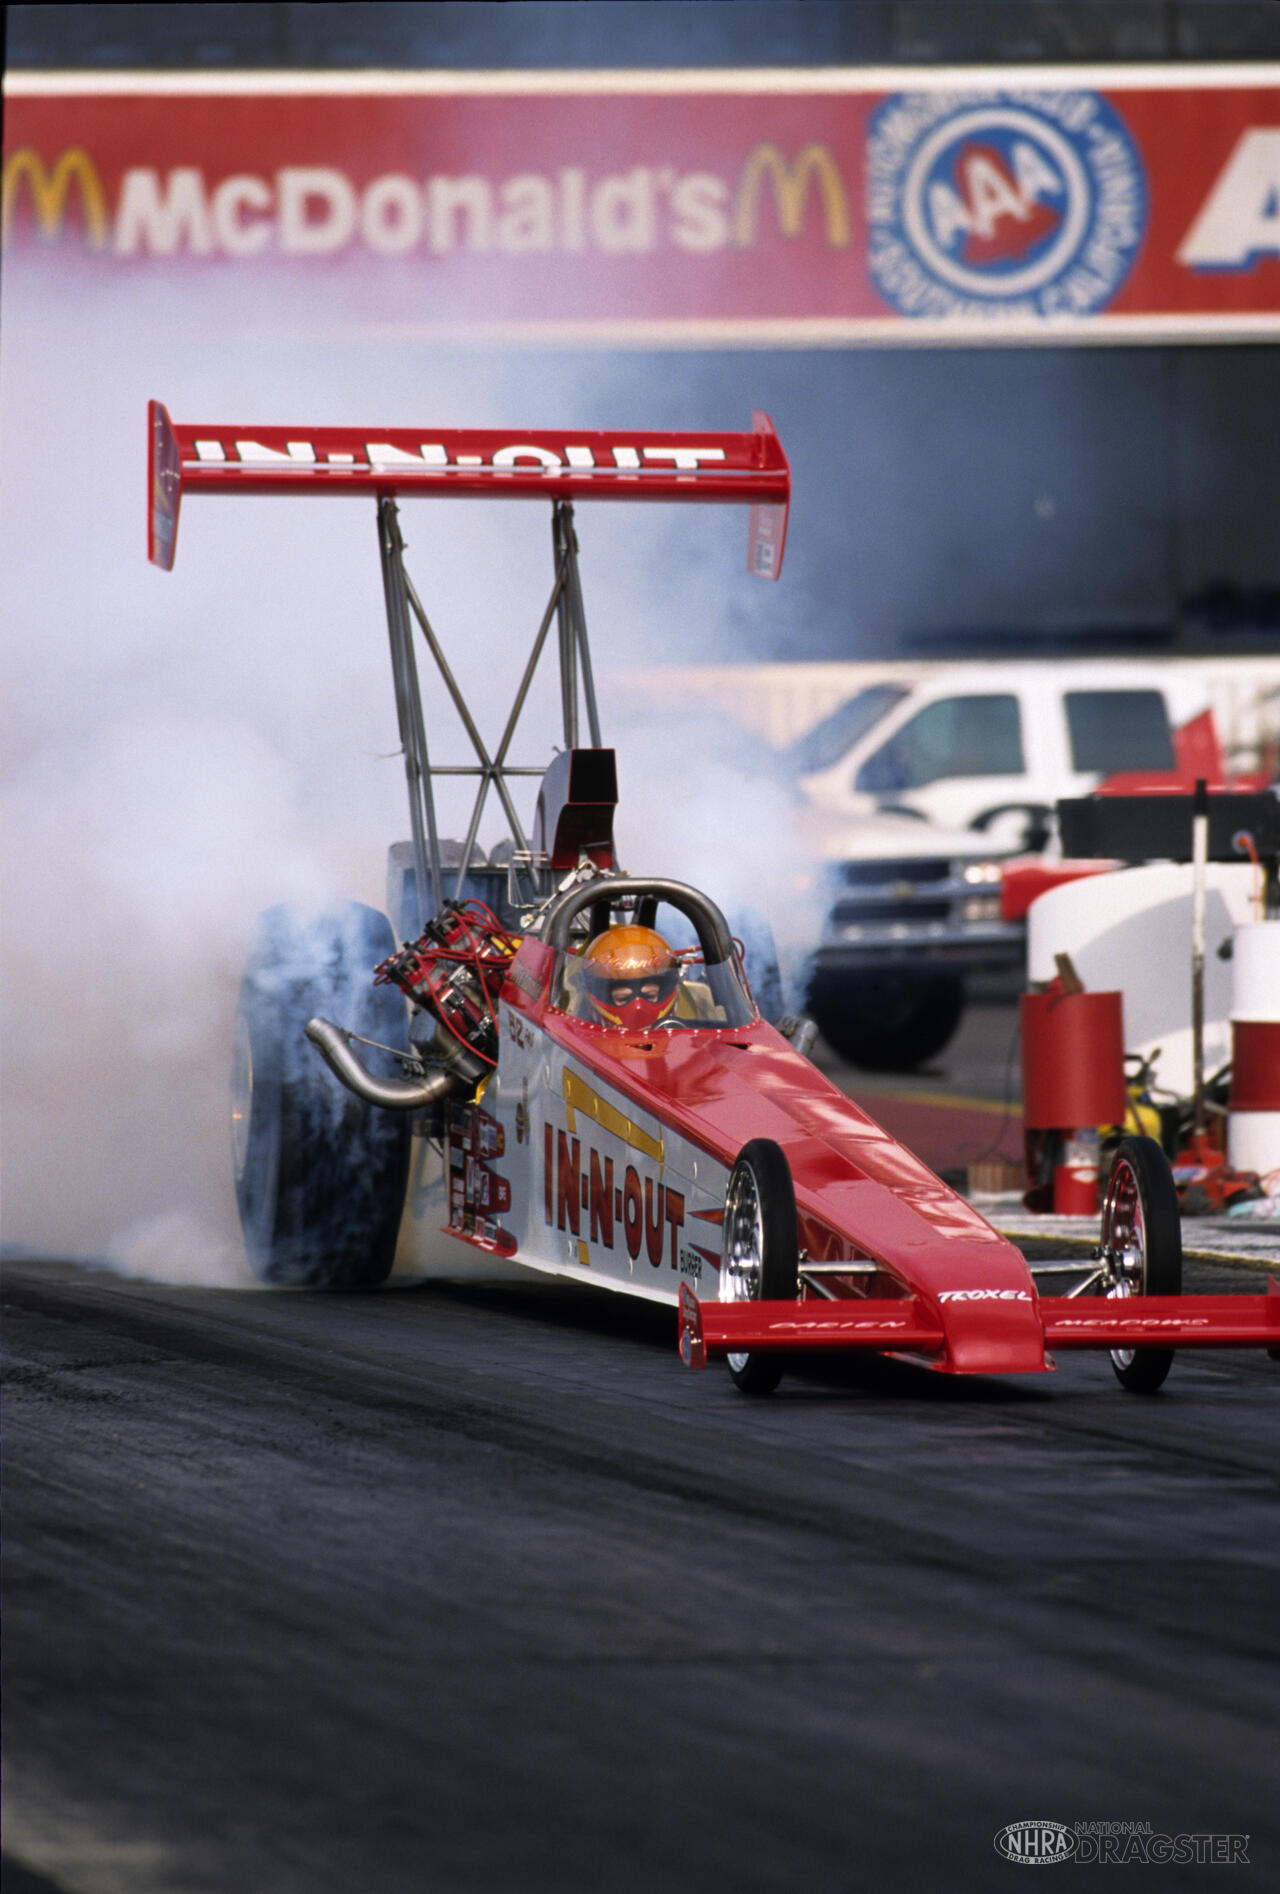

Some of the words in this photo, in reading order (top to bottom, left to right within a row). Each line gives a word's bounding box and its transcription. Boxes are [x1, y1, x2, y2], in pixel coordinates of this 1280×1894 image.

[117, 166, 729, 256] McDonald's
[927, 142, 1062, 248] AAA
[544, 1121, 685, 1271] IN-N-OUT
[937, 1289, 1033, 1304] TROXEL
